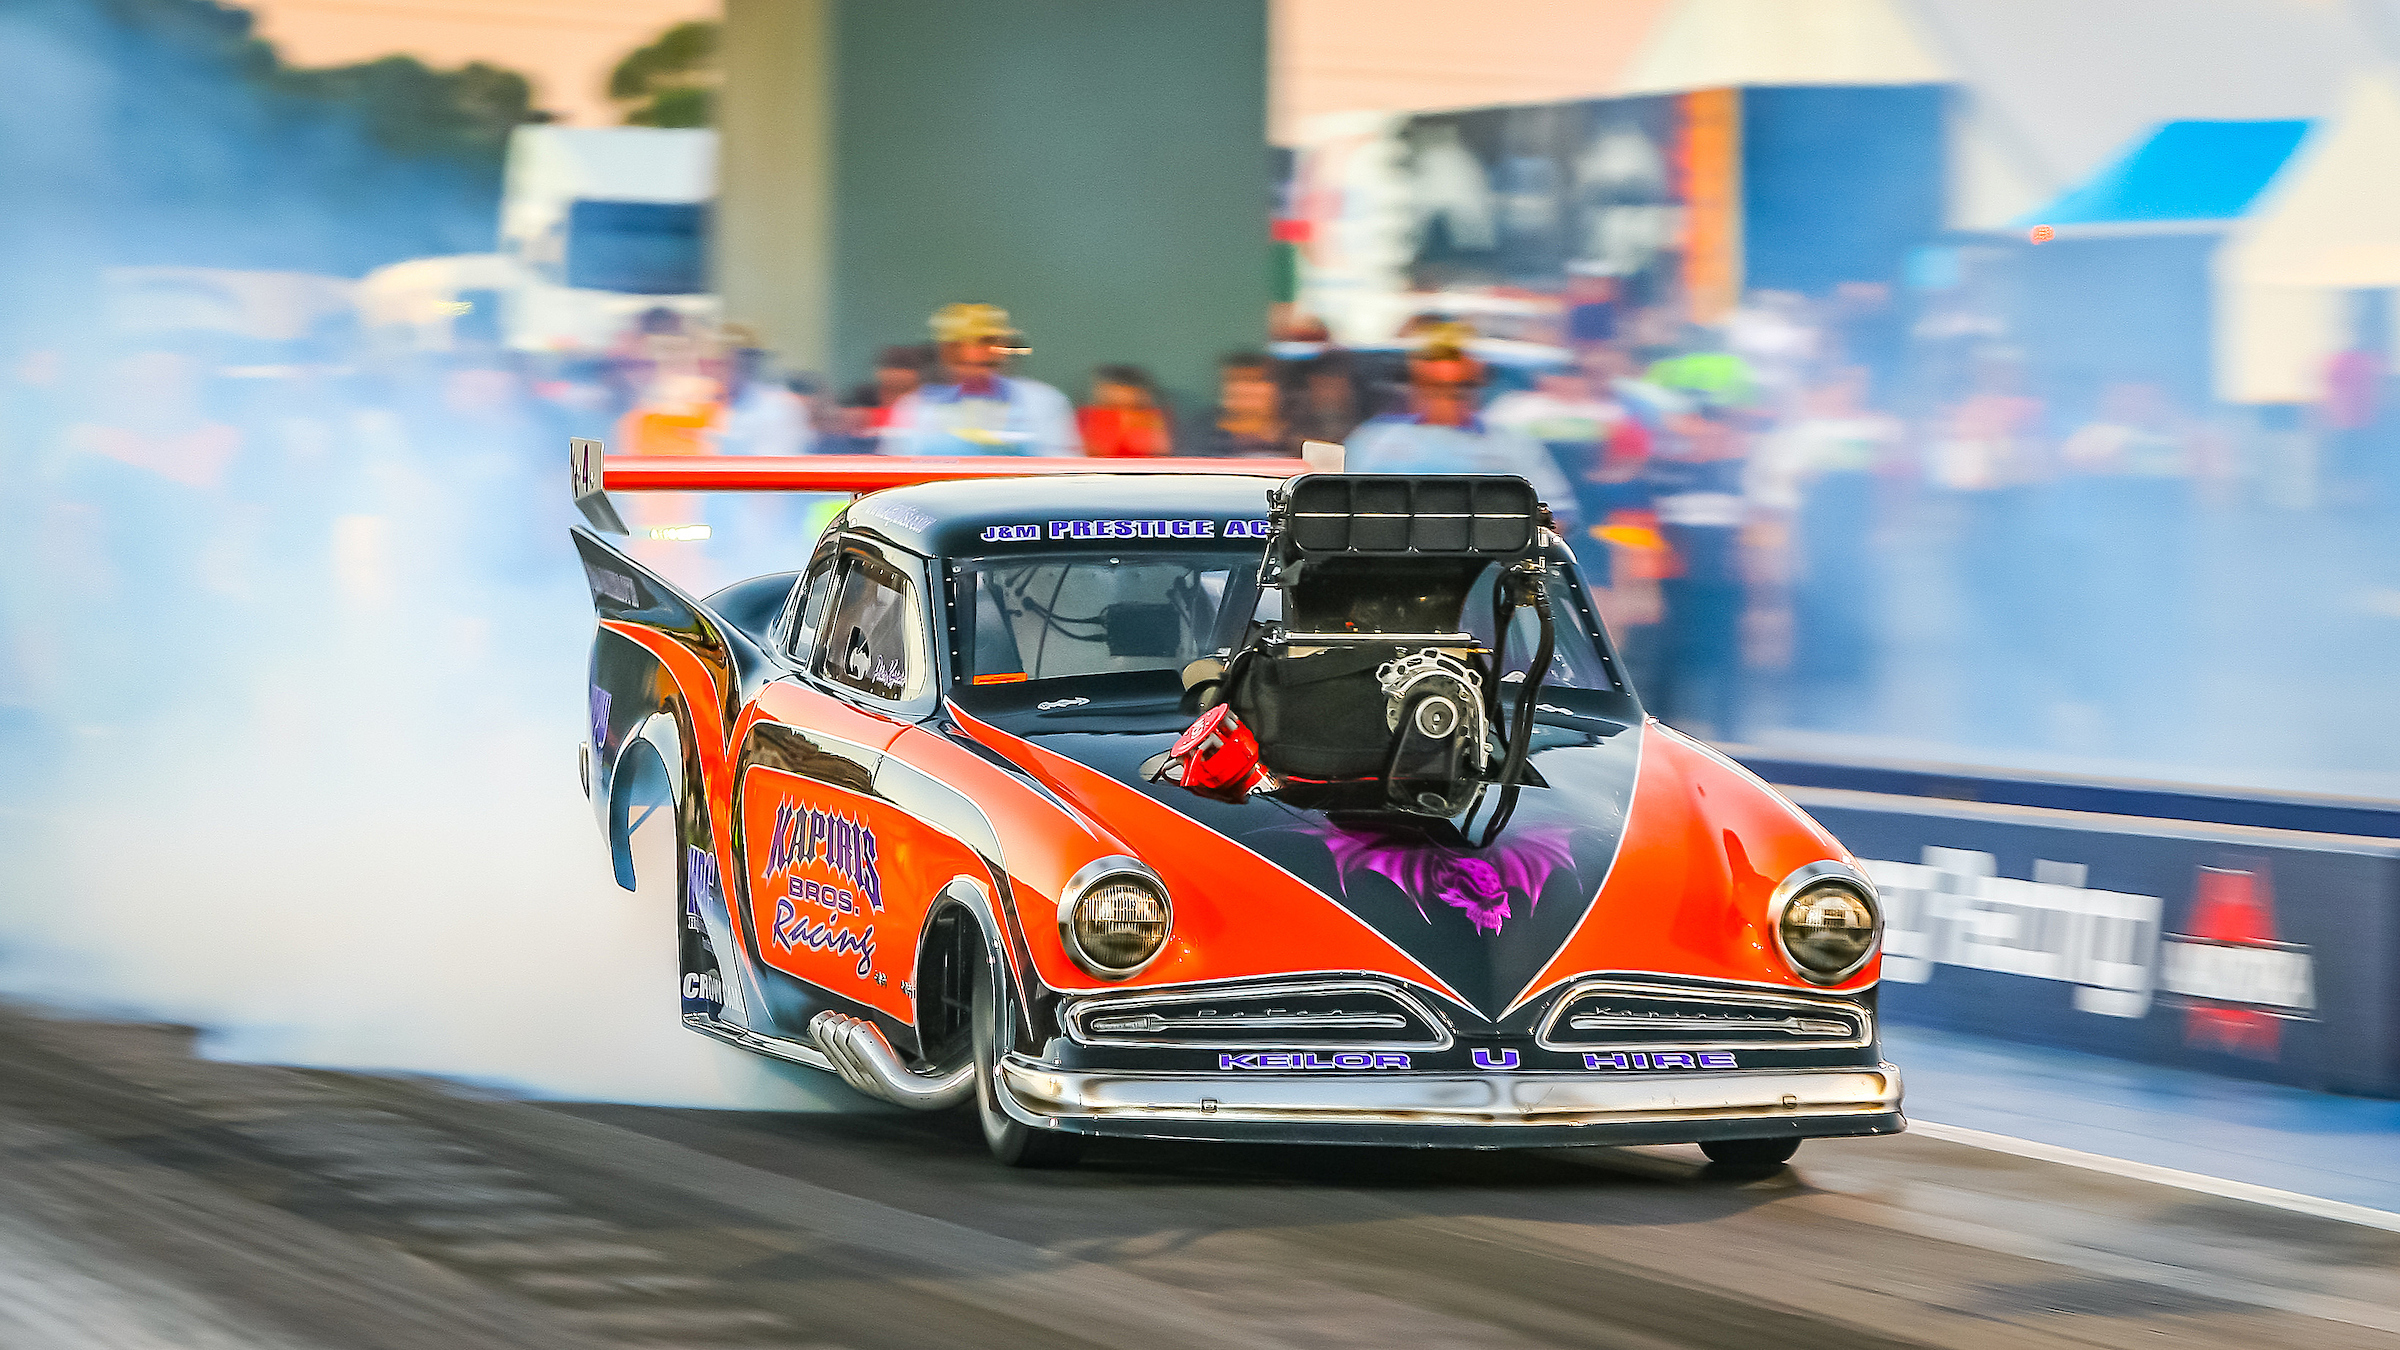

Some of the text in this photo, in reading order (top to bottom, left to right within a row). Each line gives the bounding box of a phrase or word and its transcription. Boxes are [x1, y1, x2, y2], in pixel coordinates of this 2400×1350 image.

[980, 525, 1041, 541] J&M
[1048, 520, 1215, 539] PRESTIGE
[761, 791, 885, 916] KAPIRIS
[788, 874, 860, 917] BROS.
[772, 896, 877, 979] Racing
[1218, 1048, 1739, 1070] KEILOR U HIRE
